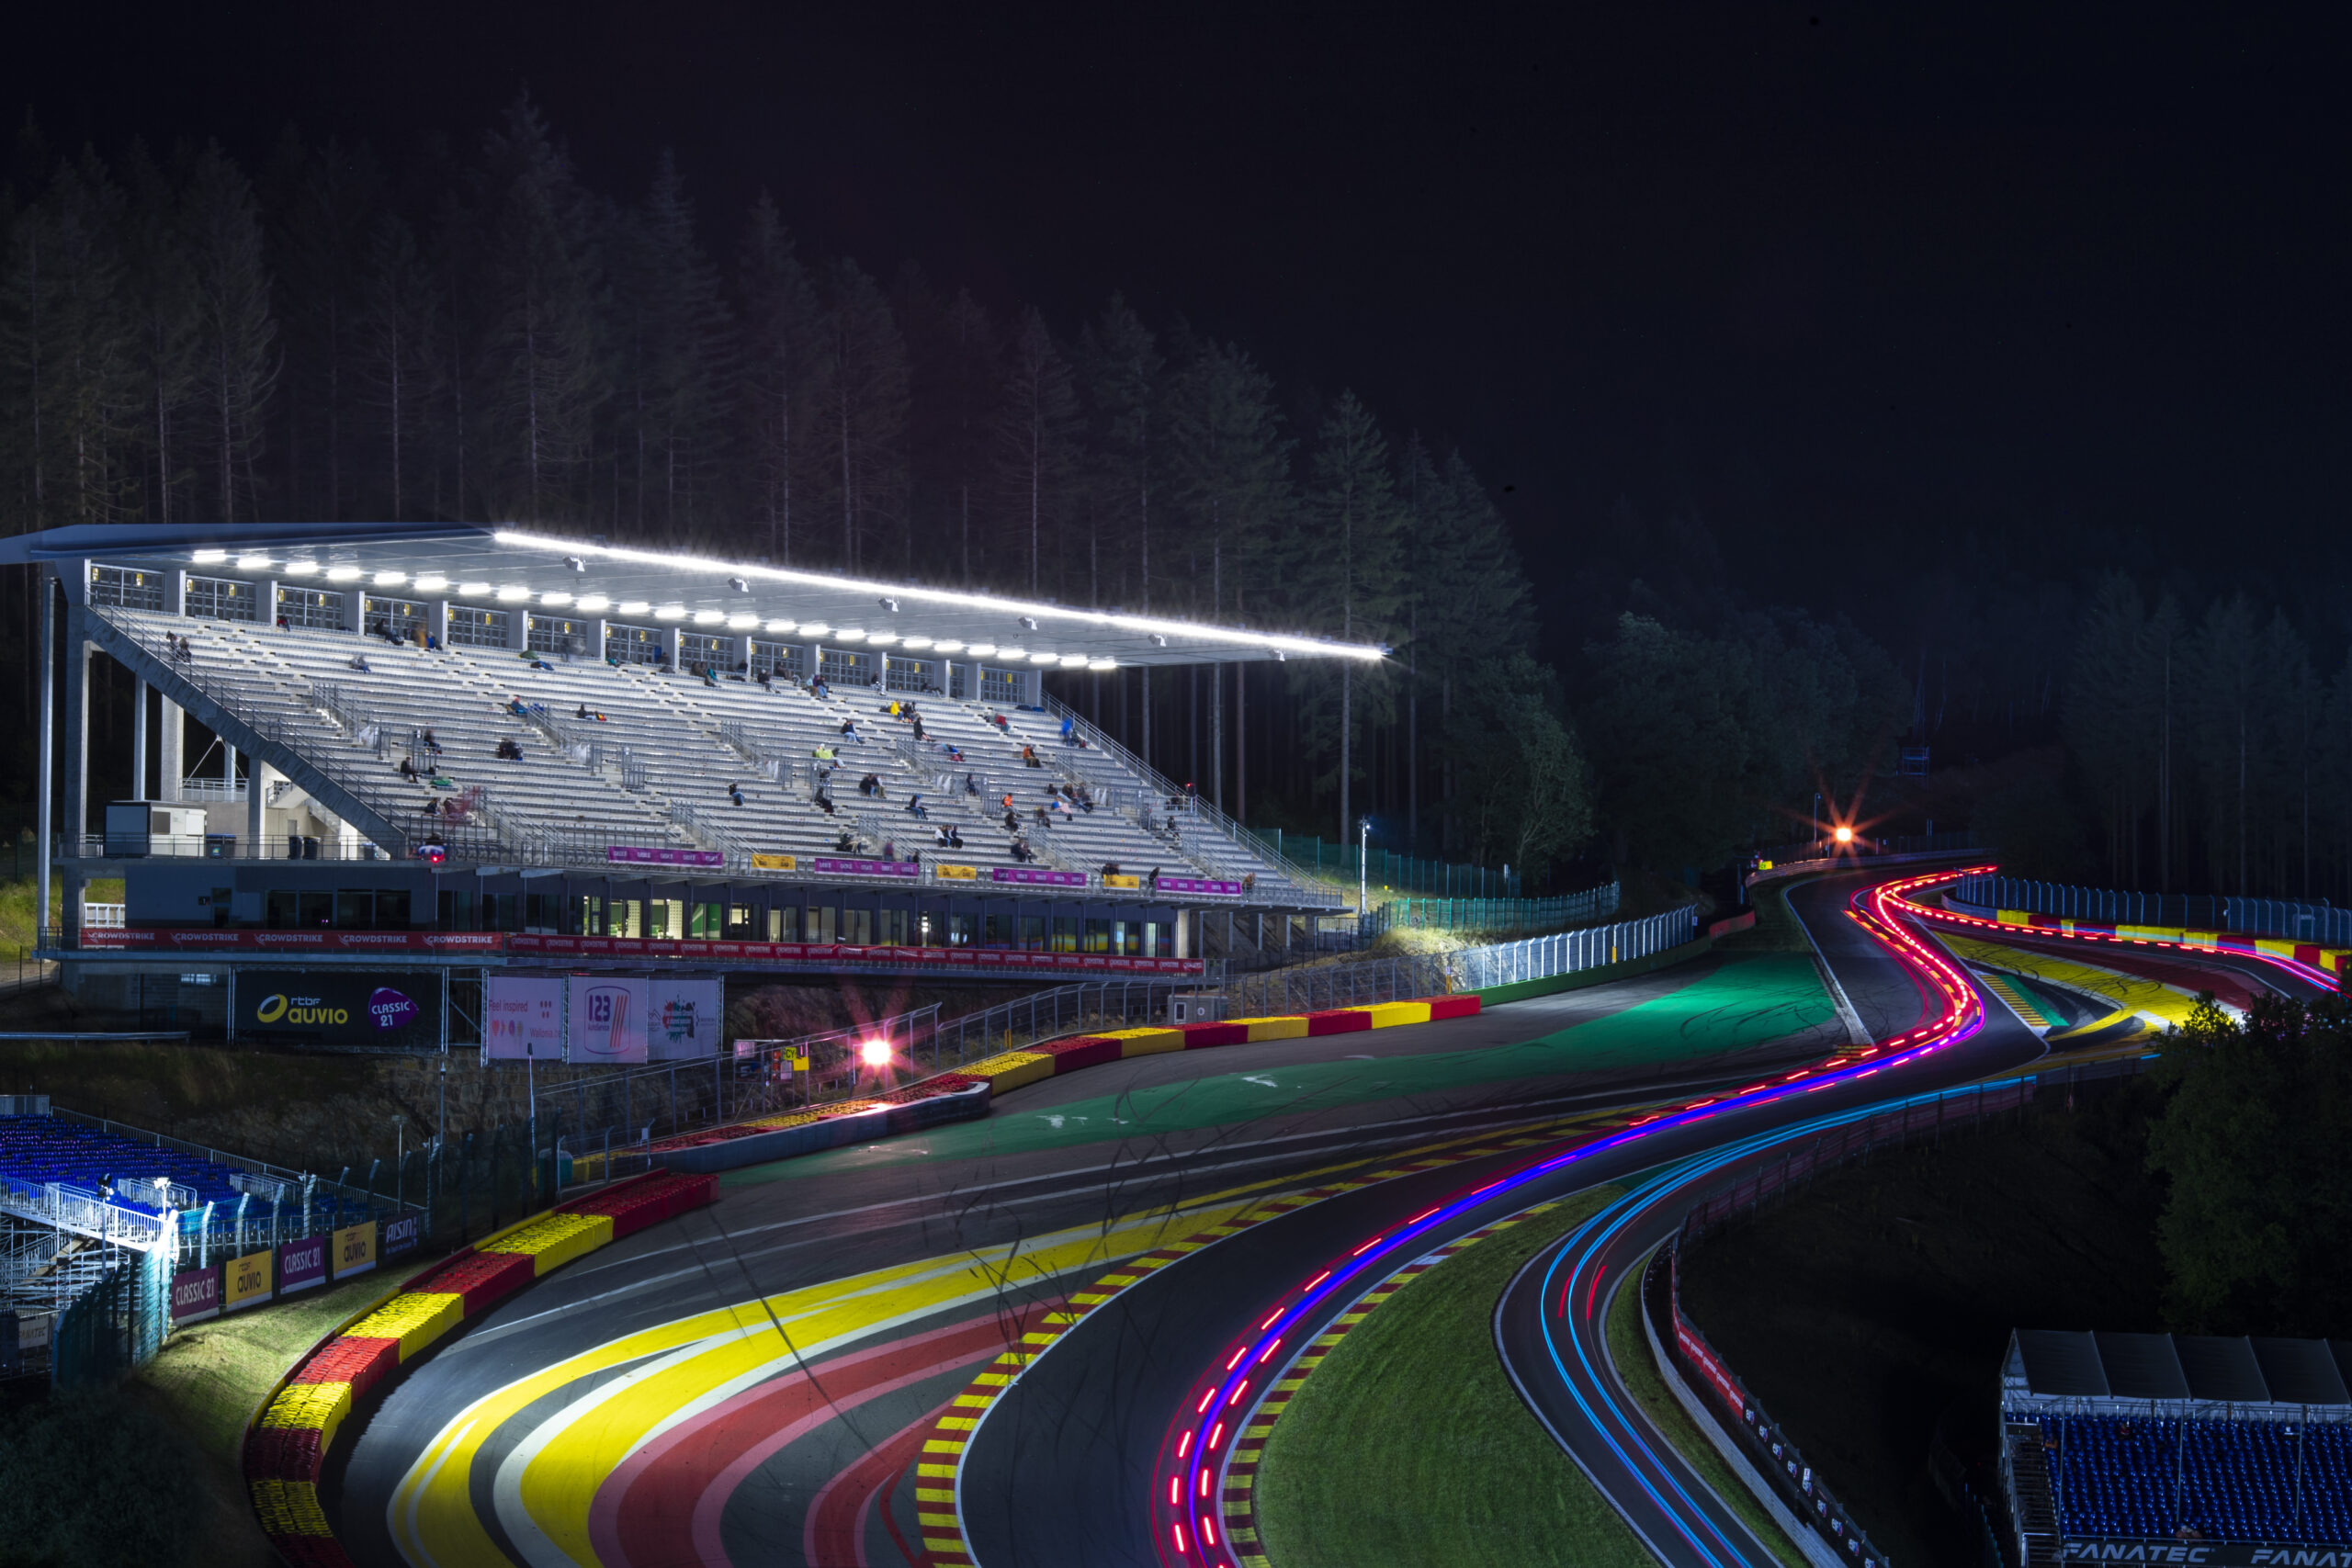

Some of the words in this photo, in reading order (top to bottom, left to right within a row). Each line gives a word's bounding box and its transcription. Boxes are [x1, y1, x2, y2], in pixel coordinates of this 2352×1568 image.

[92, 932, 155, 941] CROWDSTRIKE
[175, 933, 239, 942] CROWDSTRIKE
[258, 934, 323, 942] CROWDSTRIKE
[342, 935, 407, 943] CROWDSTRIKE
[427, 935, 492, 943] CROWDSTRIKE
[291, 996, 321, 1006] rtbf
[371, 1000, 411, 1015] CLASSIC
[489, 999, 502, 1011] Feel
[503, 999, 528, 1012] inspired
[589, 995, 611, 1021] 123
[288, 1008, 349, 1024] auvio
[380, 1014, 393, 1027] 21
[284, 1249, 312, 1275] CLASSIC
[312, 1246, 321, 1268] 21
[175, 1280, 205, 1306] CLASSIC
[206, 1276, 215, 1299] 21
[2064, 1542, 2211, 1563] FANATEC
